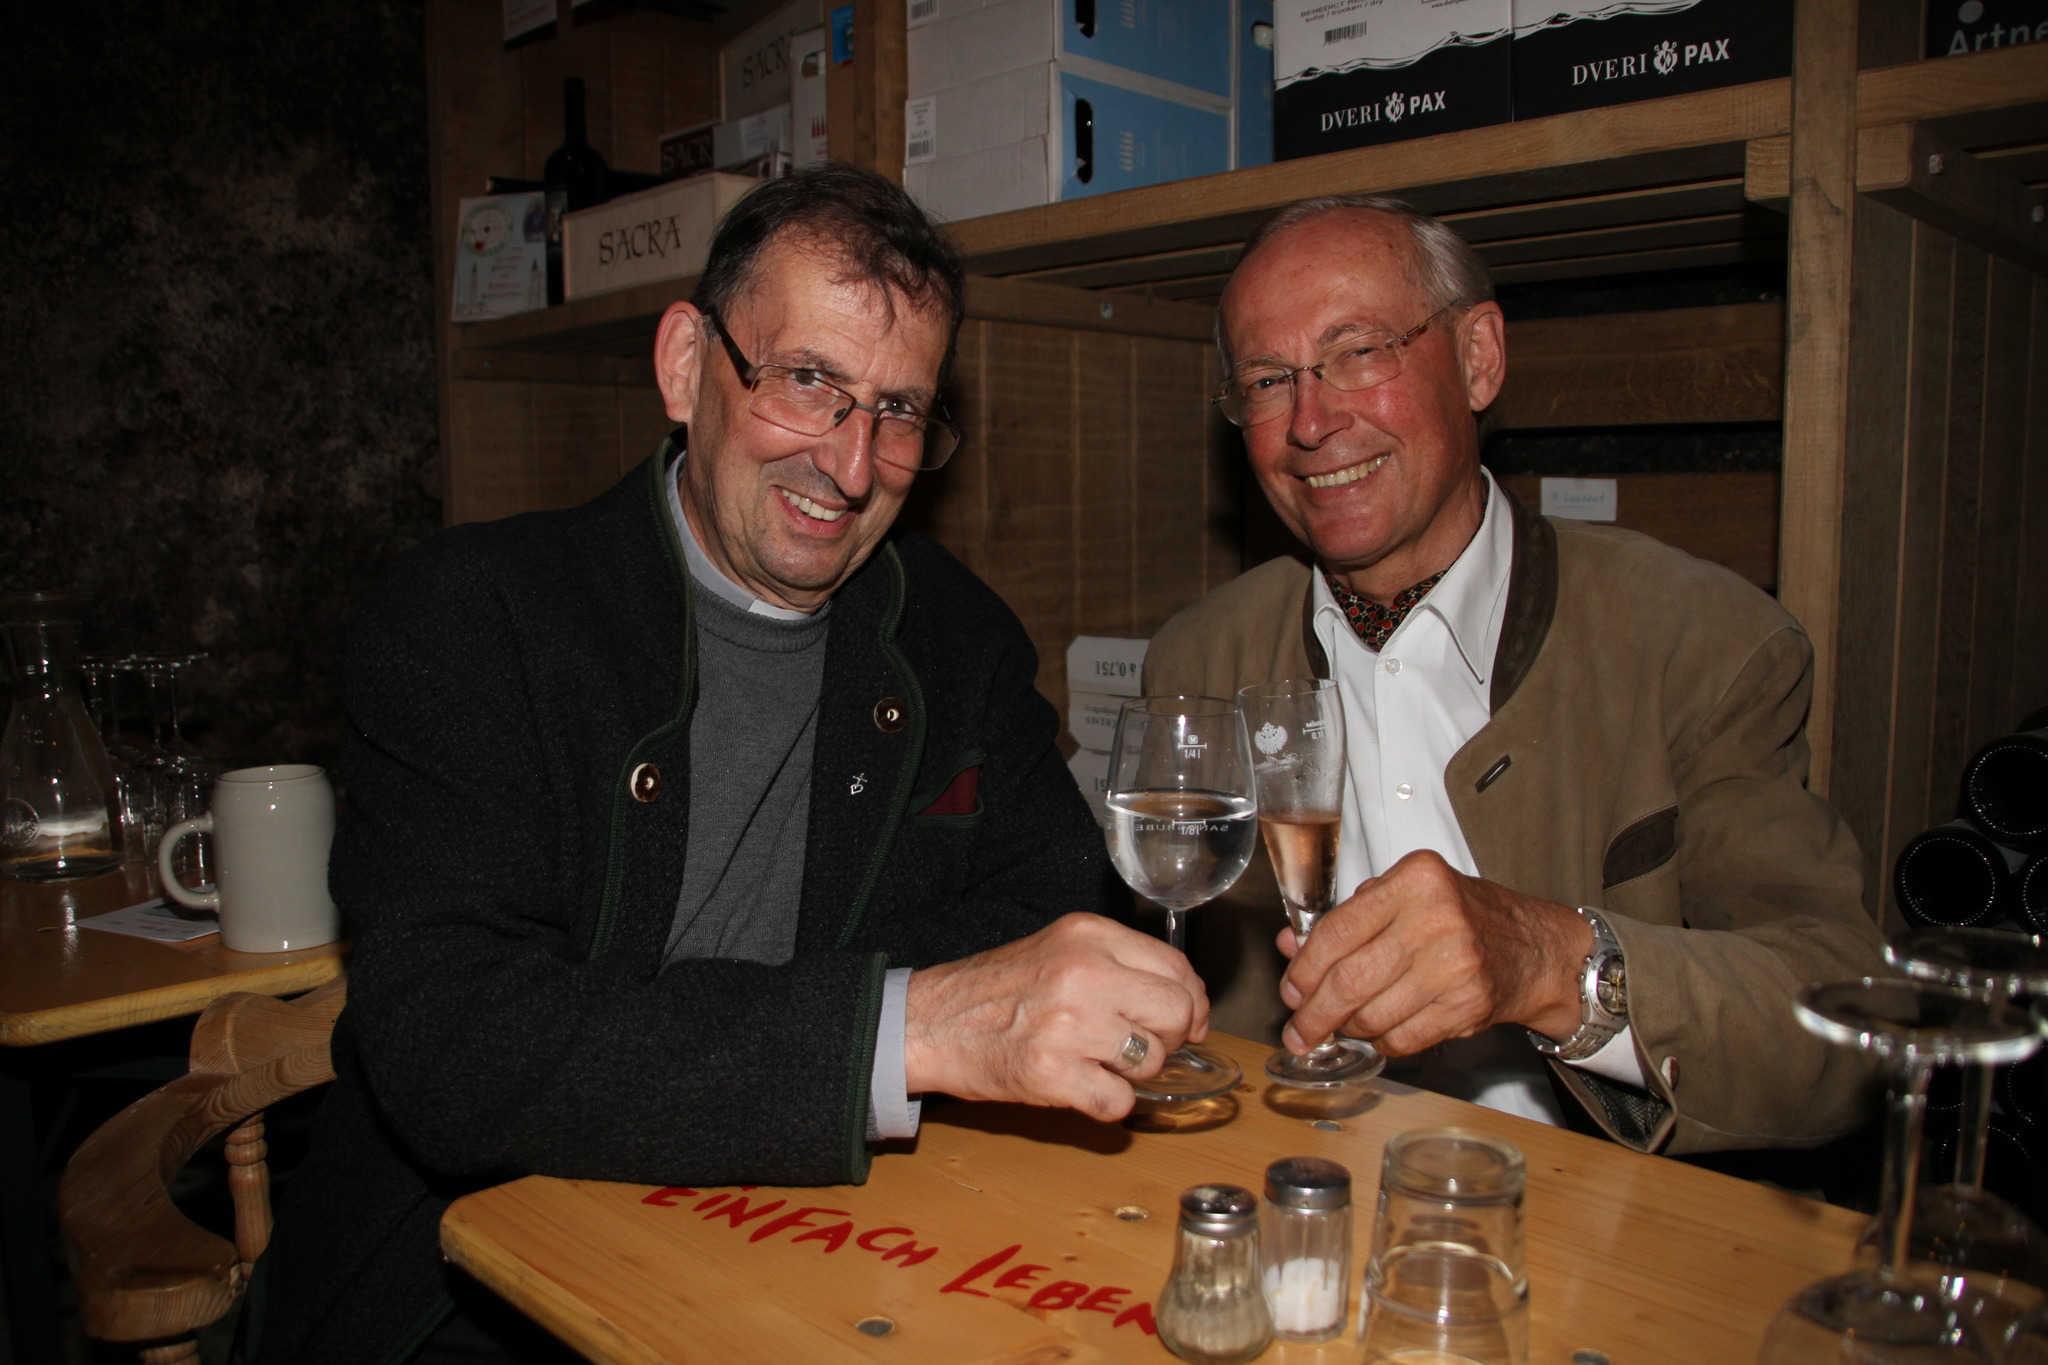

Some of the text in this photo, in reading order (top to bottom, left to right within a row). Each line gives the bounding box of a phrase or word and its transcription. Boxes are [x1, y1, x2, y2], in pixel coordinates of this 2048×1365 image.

[1572, 38, 1730, 87] DVERI PAX
[1320, 90, 1446, 132] DVERI PAX
[599, 215, 682, 267] SACRA
